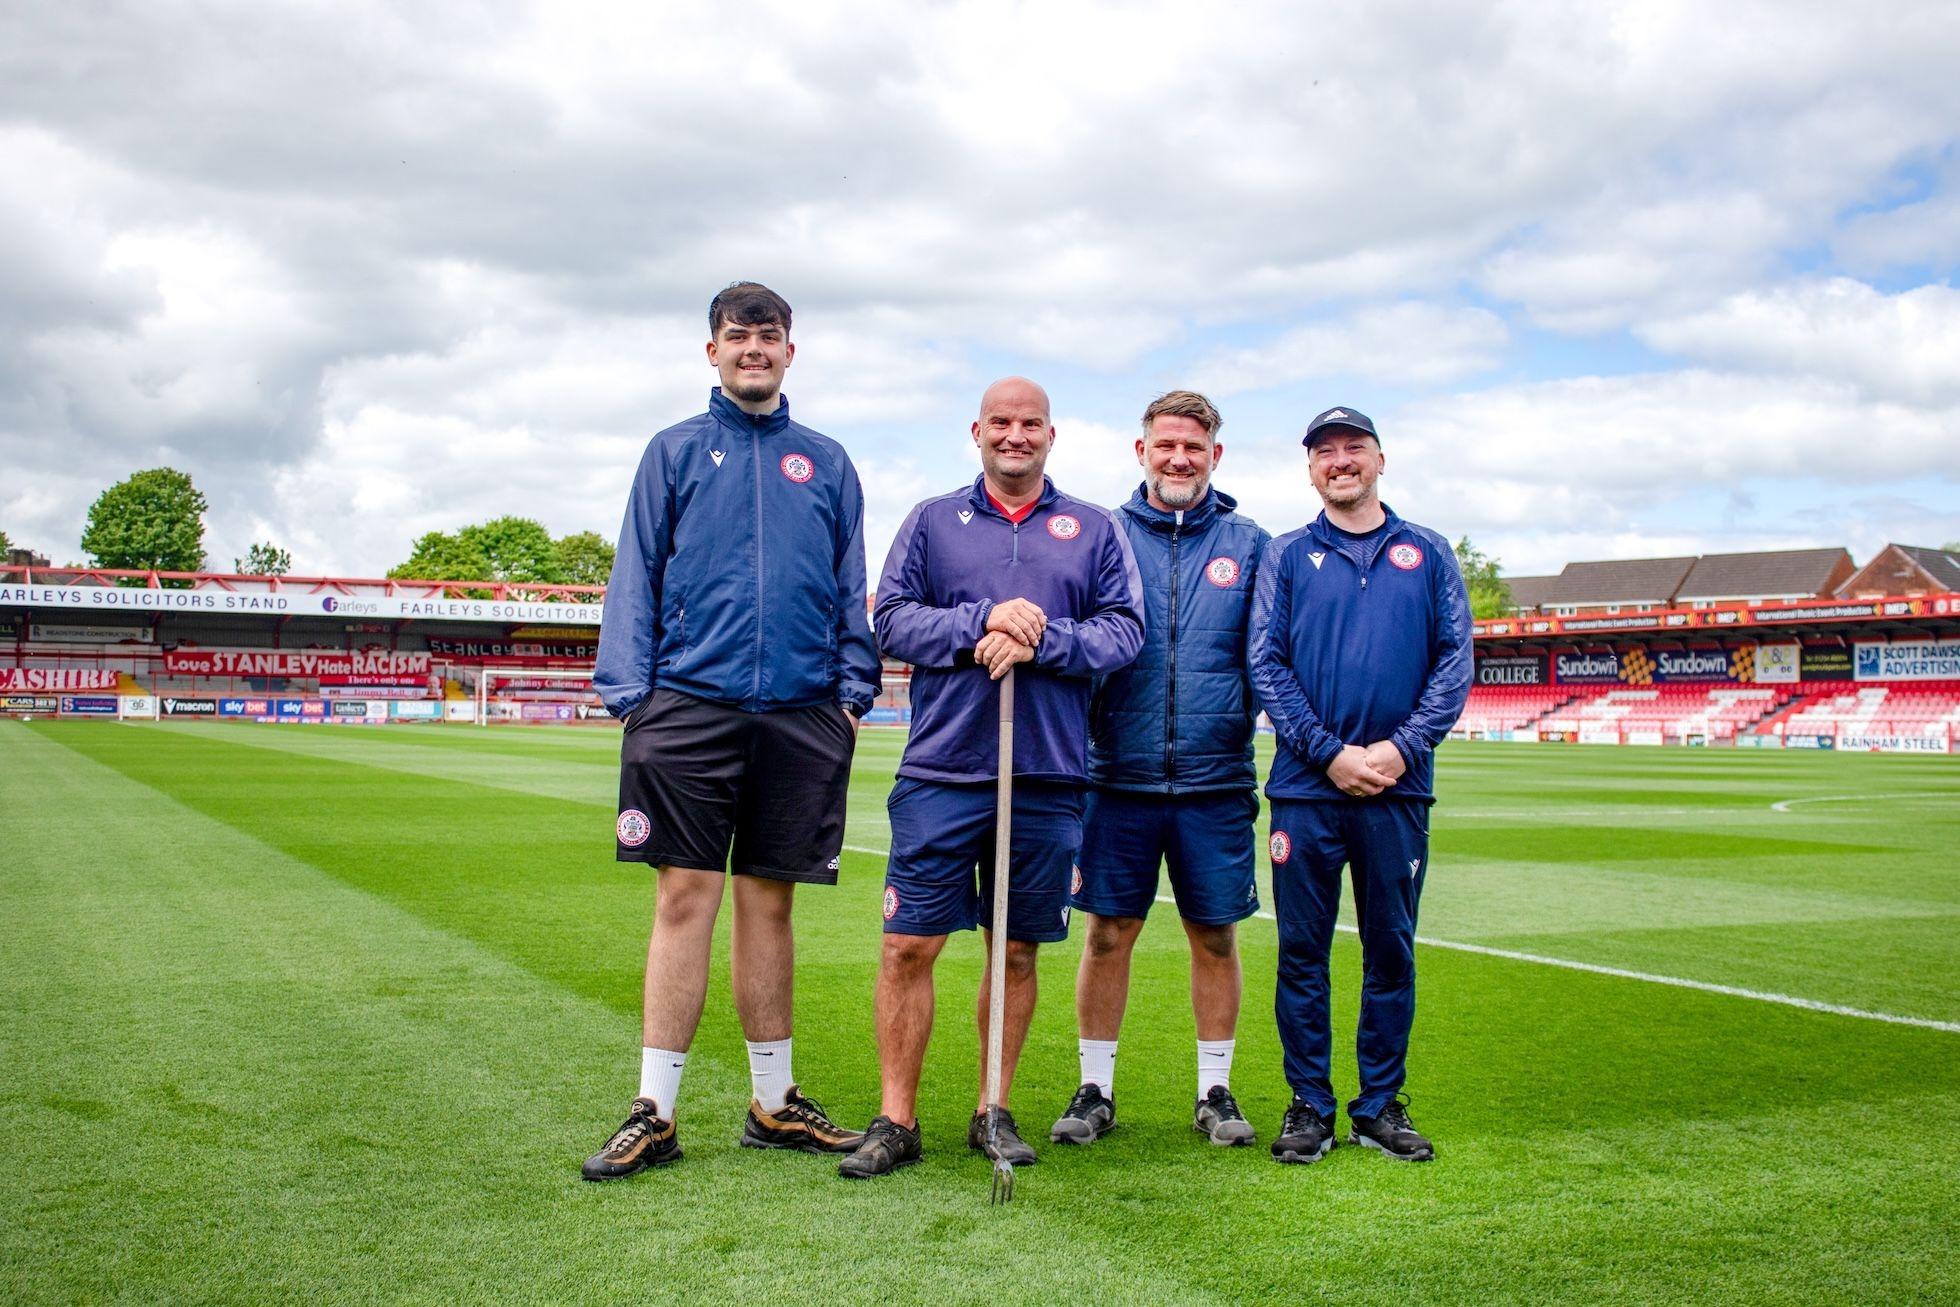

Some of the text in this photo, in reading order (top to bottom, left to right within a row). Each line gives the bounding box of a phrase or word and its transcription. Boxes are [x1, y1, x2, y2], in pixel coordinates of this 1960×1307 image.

[0, 589, 288, 609] ARLEYS SOLICITORS STAND
[401, 602, 600, 620] FARLEYS SOLICITORS
[1884, 646, 1918, 659] SCOTT
[167, 653, 428, 675] Love STANLEY Hate RACISM
[1557, 655, 1617, 676] Sundown
[1659, 652, 1726, 674] Sundown
[348, 676, 379, 684] There's
[380, 676, 397, 686] only
[1481, 666, 1540, 684] COLLEGE
[176, 702, 215, 711] macron
[225, 701, 266, 713] sky bet
[283, 702, 323, 714] sky bet
[1842, 736, 1944, 750] RAINHAM STEEL
